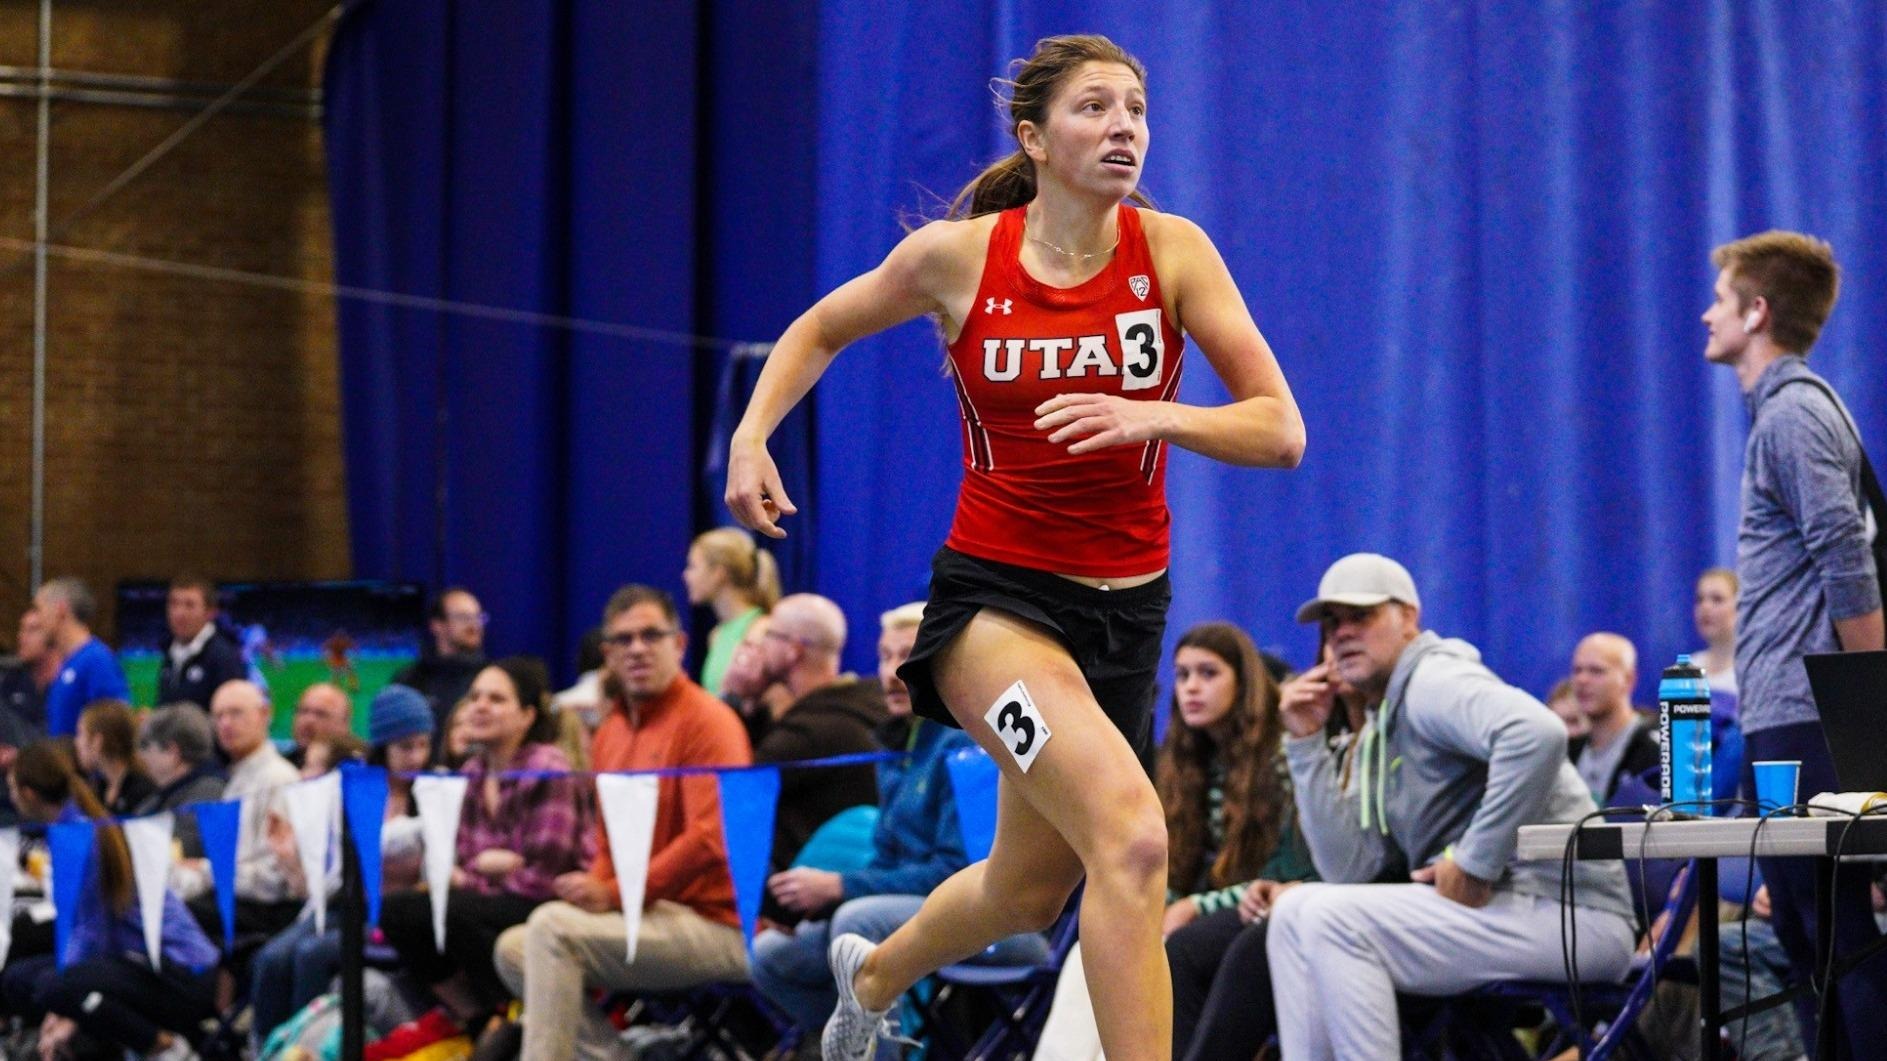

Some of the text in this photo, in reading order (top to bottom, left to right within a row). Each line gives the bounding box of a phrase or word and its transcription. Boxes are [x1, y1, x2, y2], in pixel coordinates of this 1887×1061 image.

[1136, 287, 1147, 297] 12
[983, 334, 1126, 382] UTA
[1125, 323, 1158, 378] 3
[997, 701, 1036, 756] 3
[1660, 701, 1671, 799] POWERADE
